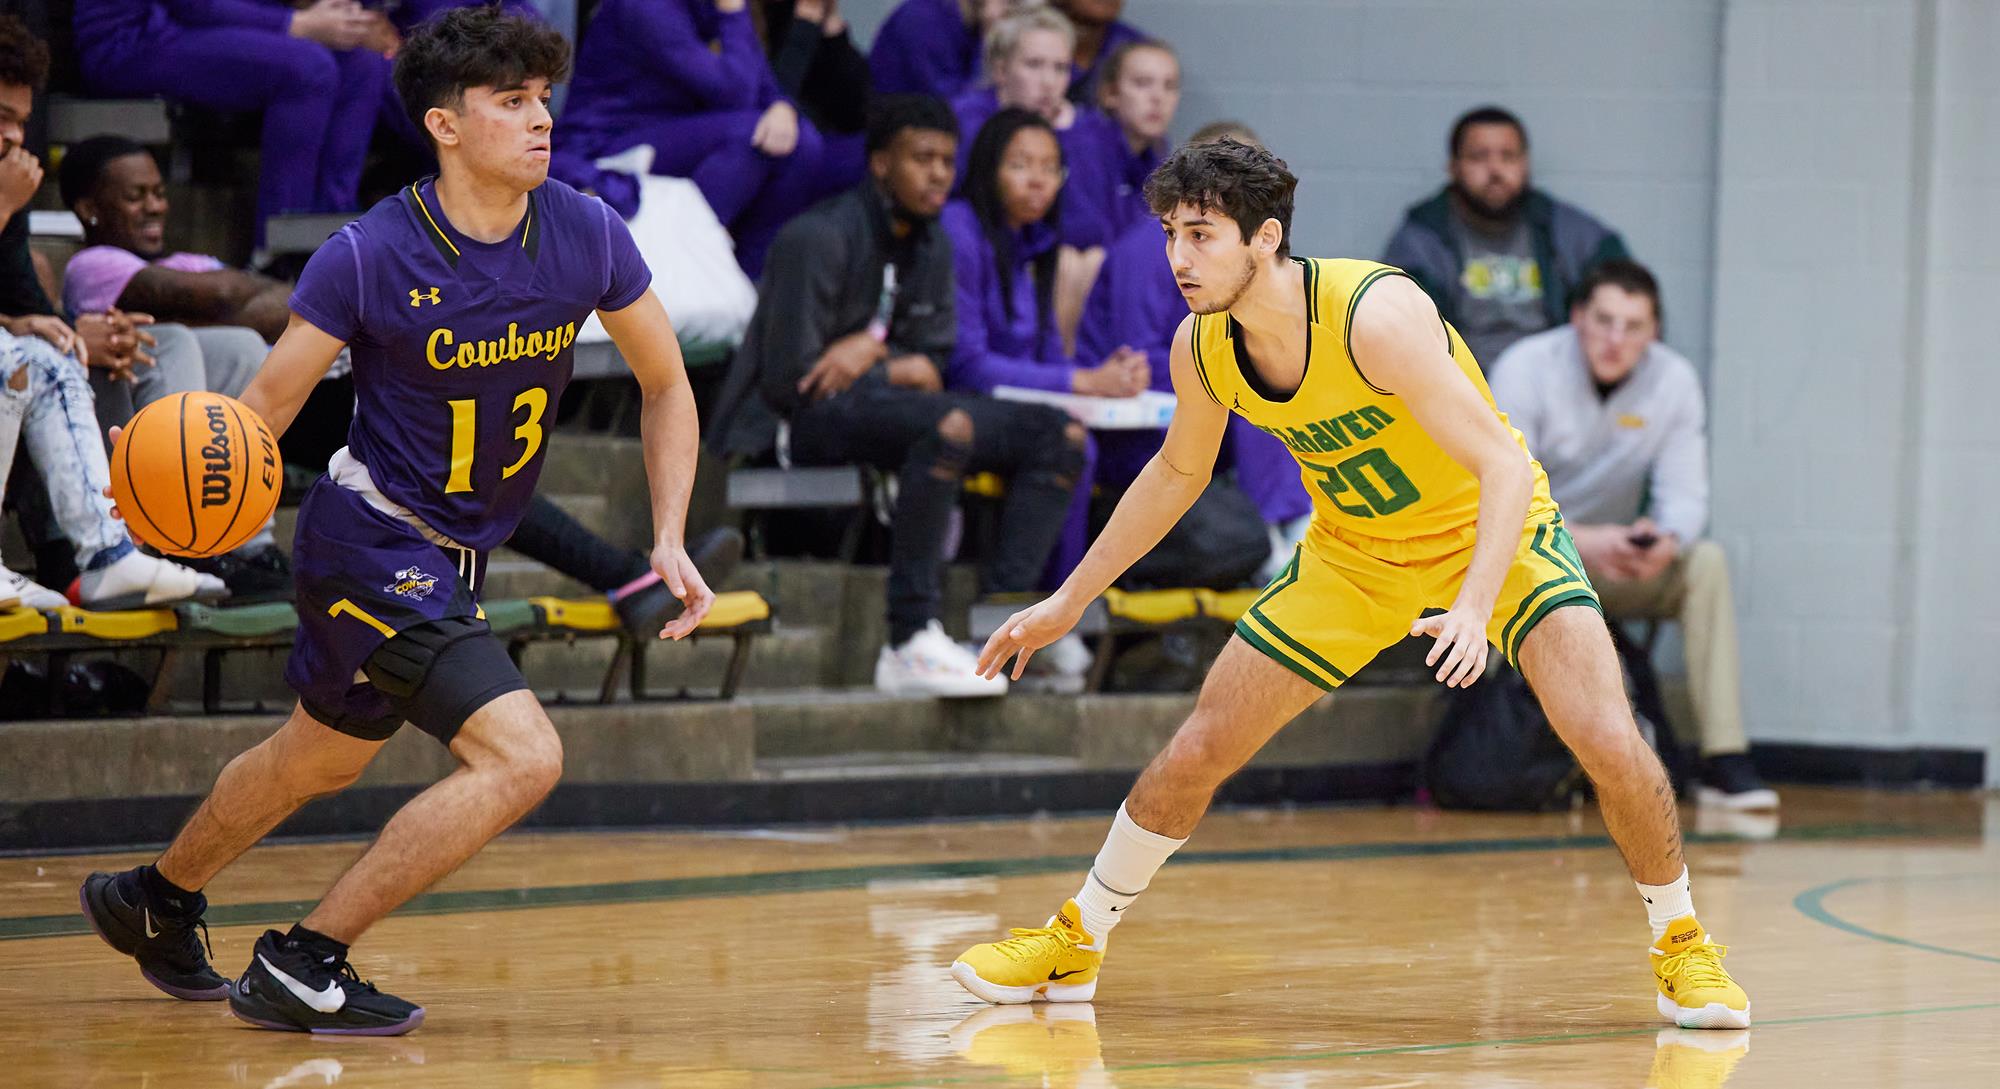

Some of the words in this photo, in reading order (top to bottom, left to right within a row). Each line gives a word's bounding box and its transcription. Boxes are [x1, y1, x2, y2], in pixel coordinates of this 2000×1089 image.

[426, 322, 575, 371] Cowboys
[201, 405, 232, 509] Wilson
[444, 387, 548, 494] 13
[1297, 447, 1421, 519] 20
